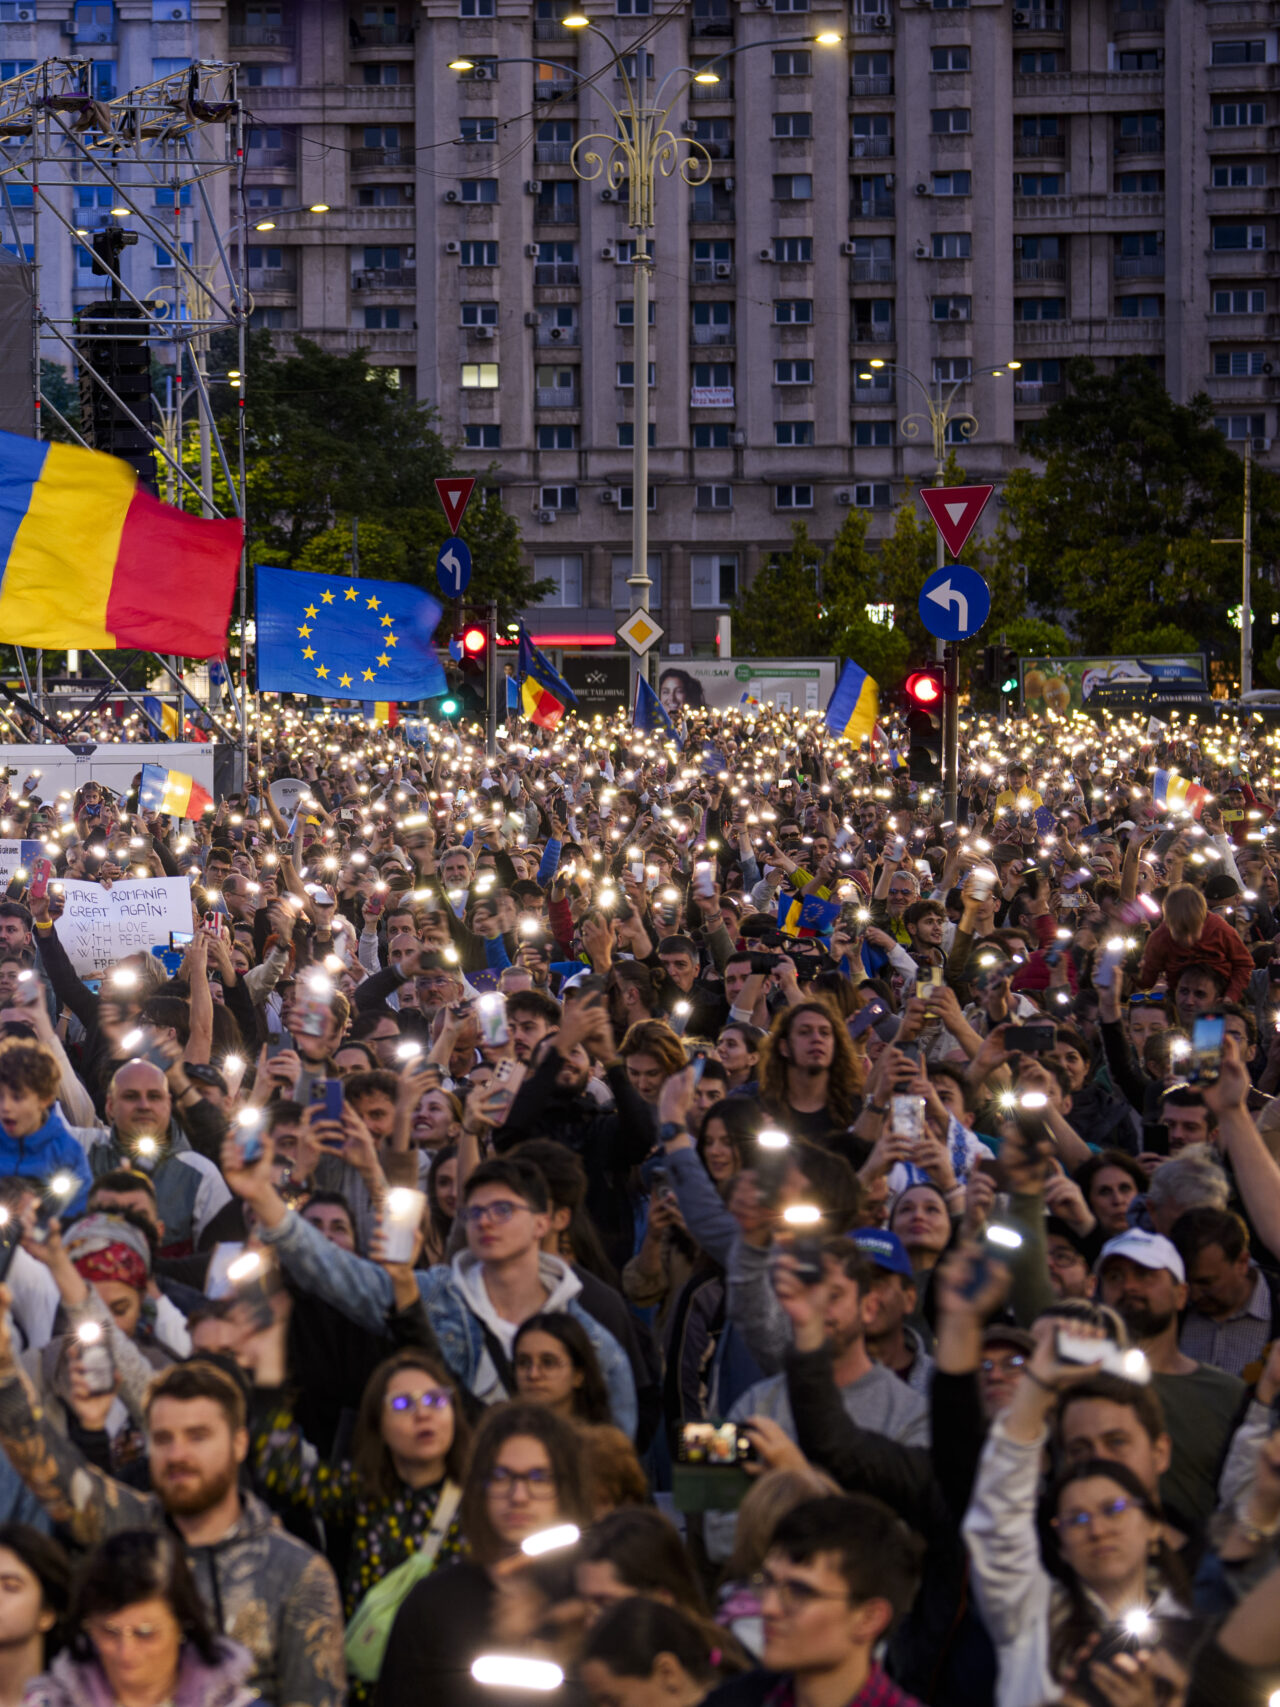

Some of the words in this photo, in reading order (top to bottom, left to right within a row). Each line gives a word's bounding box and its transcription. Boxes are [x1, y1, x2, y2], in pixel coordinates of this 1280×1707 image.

[1163, 668, 1181, 676] NOU
[65, 890, 98, 904] MAKE
[111, 887, 168, 903] ROMANIA
[70, 907, 110, 917] GREAT
[118, 922, 150, 933] LOVE
[120, 934, 157, 946] PEACE
